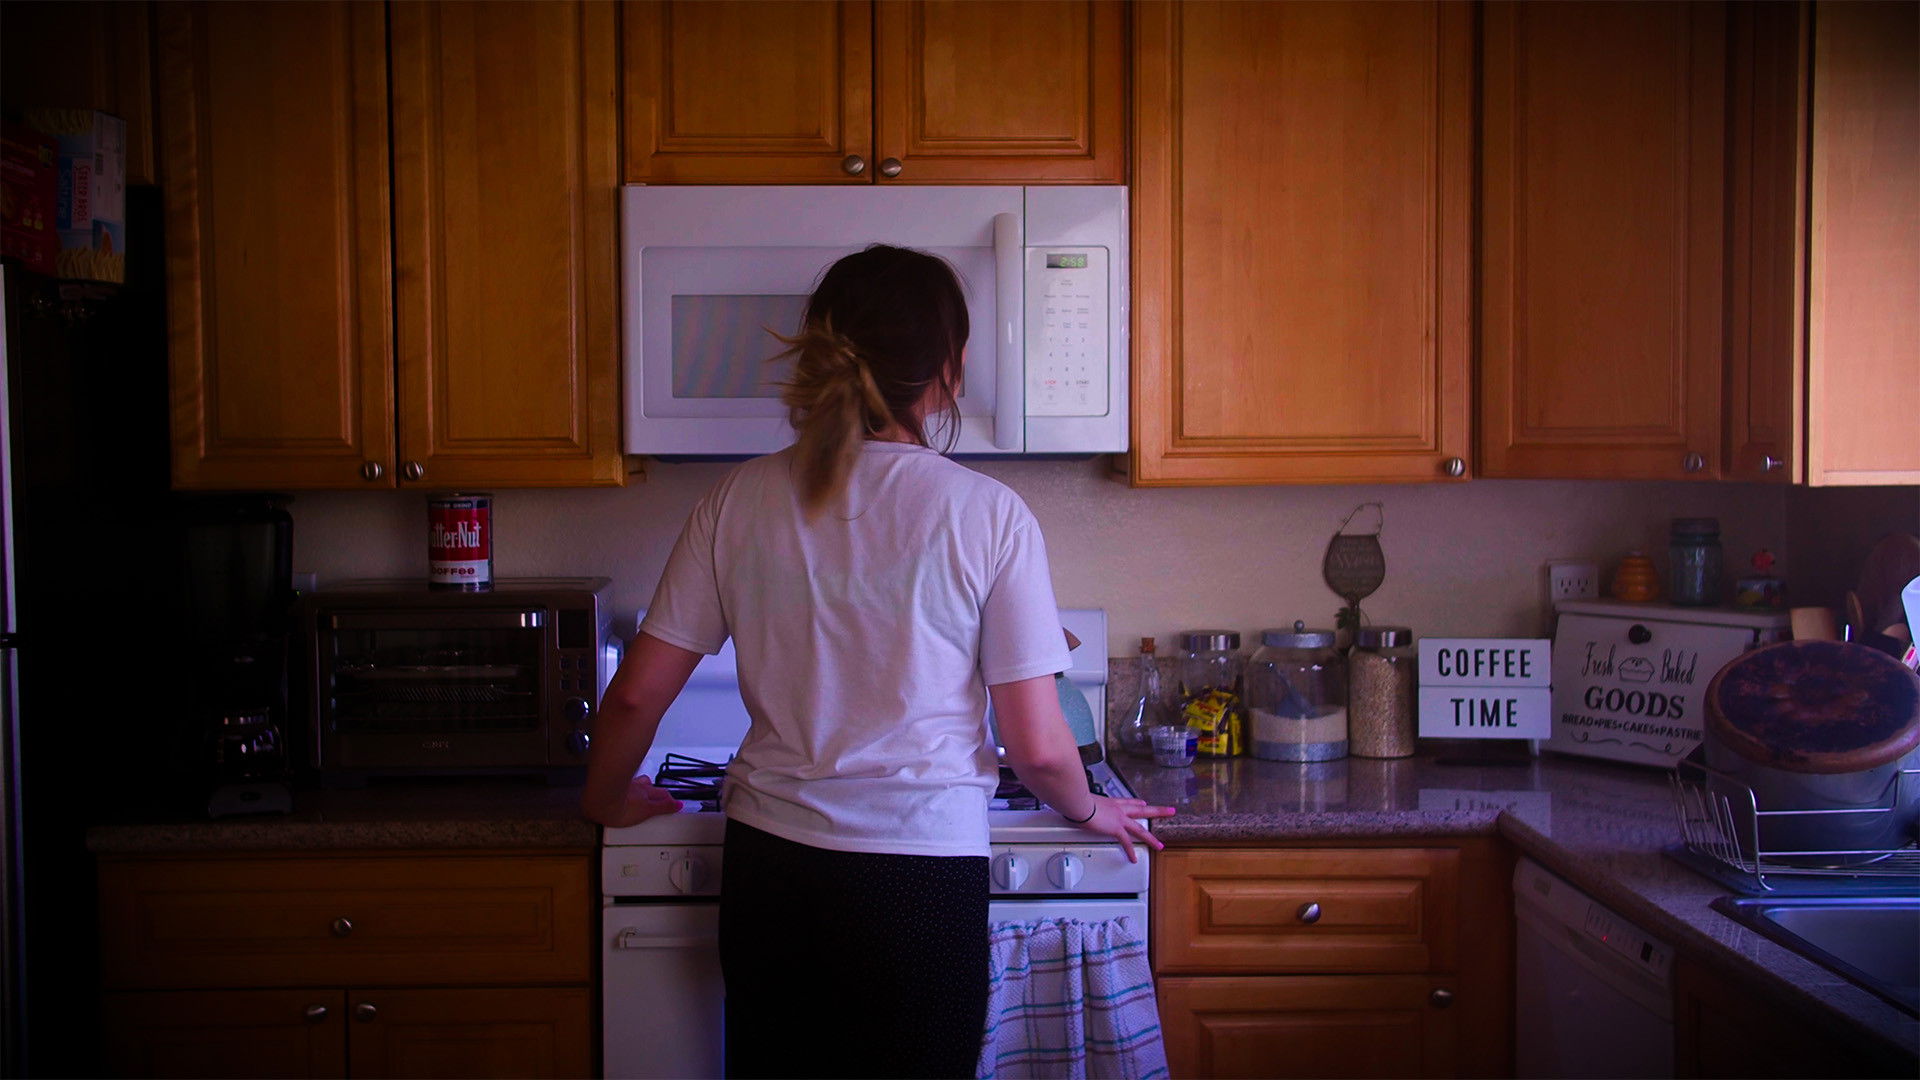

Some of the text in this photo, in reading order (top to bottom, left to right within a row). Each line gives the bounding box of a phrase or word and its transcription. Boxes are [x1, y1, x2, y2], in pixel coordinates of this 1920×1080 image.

[1437, 649, 1532, 678] COFFEE
[1582, 641, 1698, 685] Fresh Baked
[1450, 699, 1518, 727] TIME
[1584, 686, 1685, 719] GOODS
